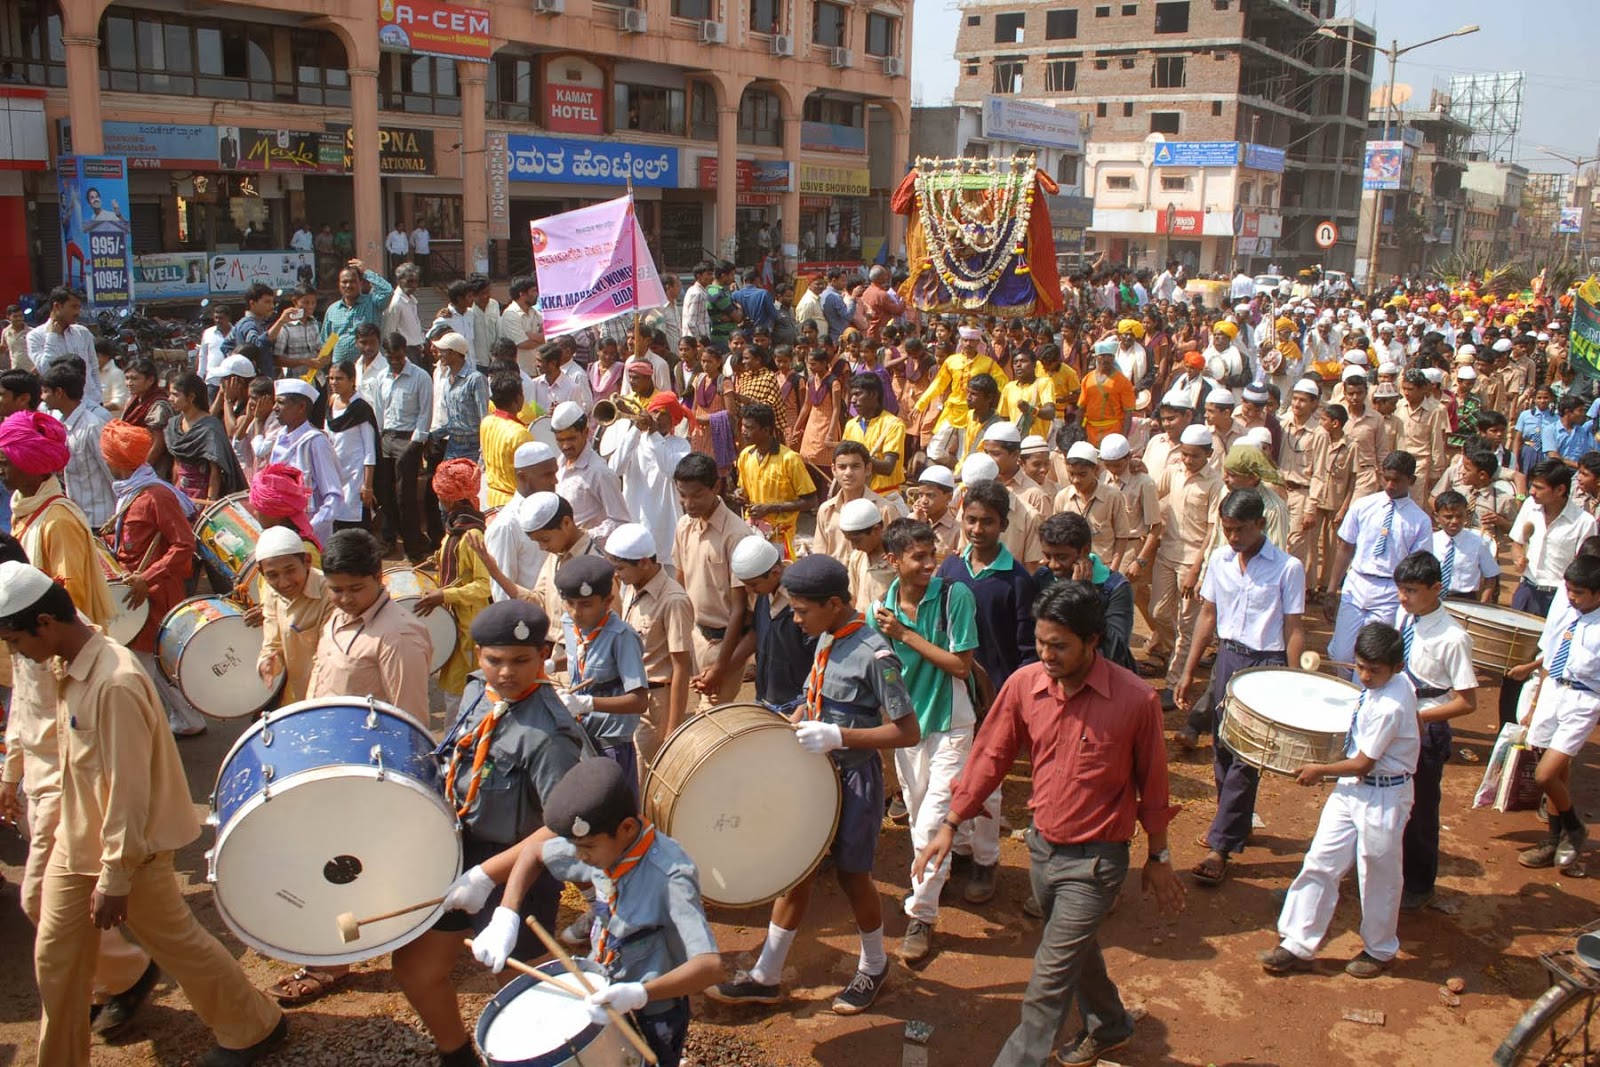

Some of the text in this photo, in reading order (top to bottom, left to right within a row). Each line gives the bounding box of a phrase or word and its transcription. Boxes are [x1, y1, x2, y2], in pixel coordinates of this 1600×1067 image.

[396, 5, 489, 35] A-CEM
[556, 89, 592, 104] KAMAT
[551, 104, 598, 121] HOTEL
[346, 128, 419, 153] SPNA
[132, 158, 161, 168] ATM
[800, 180, 823, 192] USIVE
[825, 182, 867, 194] SHOWROOM
[91, 236, 125, 255] 995/-
[93, 270, 128, 289] 1095/-
[142, 266, 181, 281] WELL
